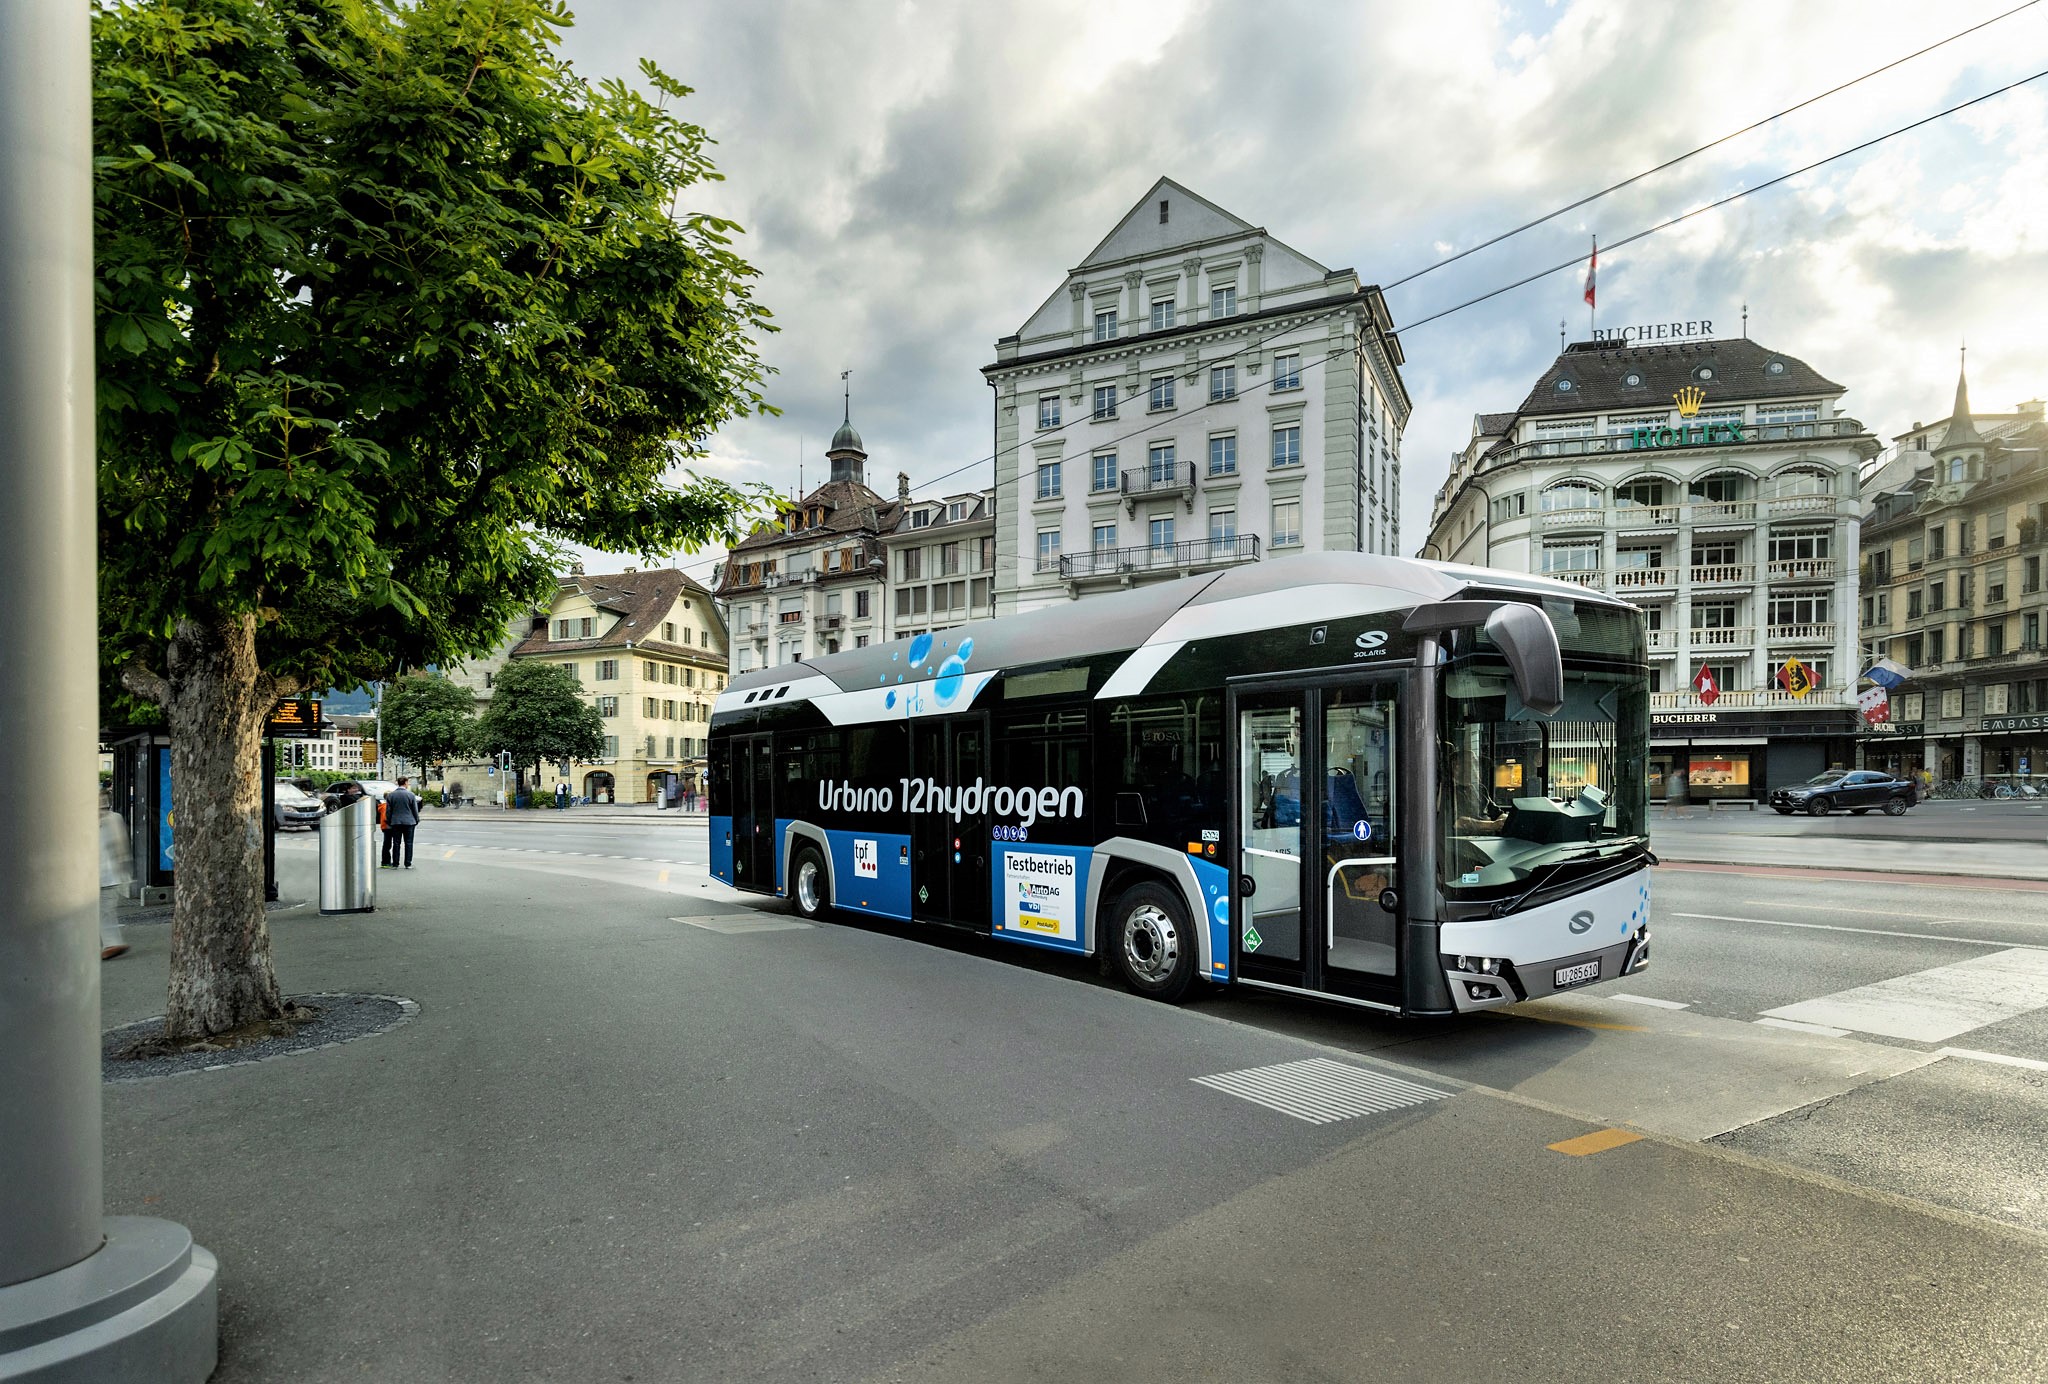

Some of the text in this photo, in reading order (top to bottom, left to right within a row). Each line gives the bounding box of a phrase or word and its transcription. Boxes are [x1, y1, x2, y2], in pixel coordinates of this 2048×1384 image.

[1592, 320, 1714, 344] BUCHERER
[1632, 422, 1746, 449] ROLEX
[1353, 649, 1387, 658] SOLARIS
[1652, 714, 1717, 724] BUCHERER
[819, 779, 893, 812] Urbino
[855, 842, 869, 863] tpf
[1007, 855, 1073, 876] Testbetrieb
